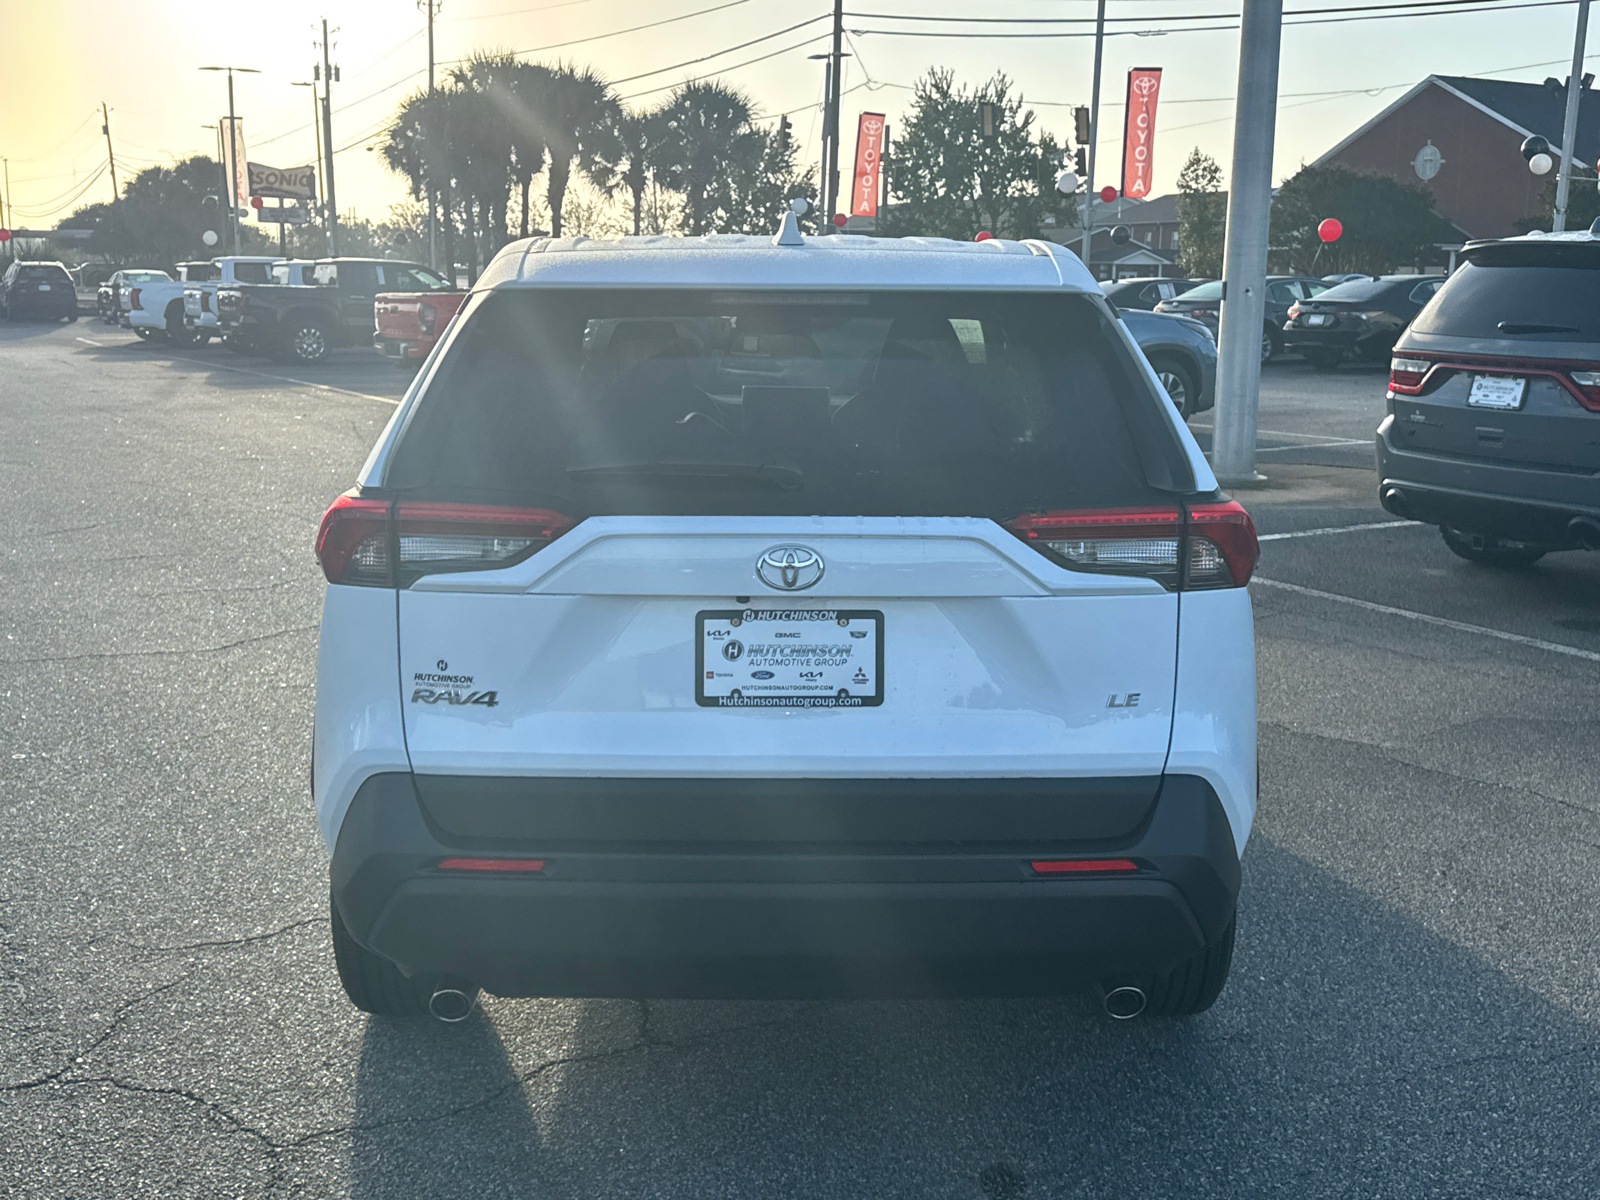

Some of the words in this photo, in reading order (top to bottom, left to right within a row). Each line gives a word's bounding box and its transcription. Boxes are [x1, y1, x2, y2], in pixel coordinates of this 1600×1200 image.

[1131, 98, 1149, 192] TOYOTA
[253, 171, 309, 187] SONIC
[859, 137, 876, 212] TOYOTA
[757, 610, 838, 621] HUTCHINSON
[747, 644, 852, 657] HUTCHINSON
[748, 658, 811, 667] AUTOMOTIVE
[814, 658, 848, 667] GROUP
[414, 672, 474, 683] HUTCHINSON
[410, 688, 500, 707] RAV4
[719, 695, 862, 708] Hutchinsonautogroup.com
[1105, 692, 1141, 708] LE
